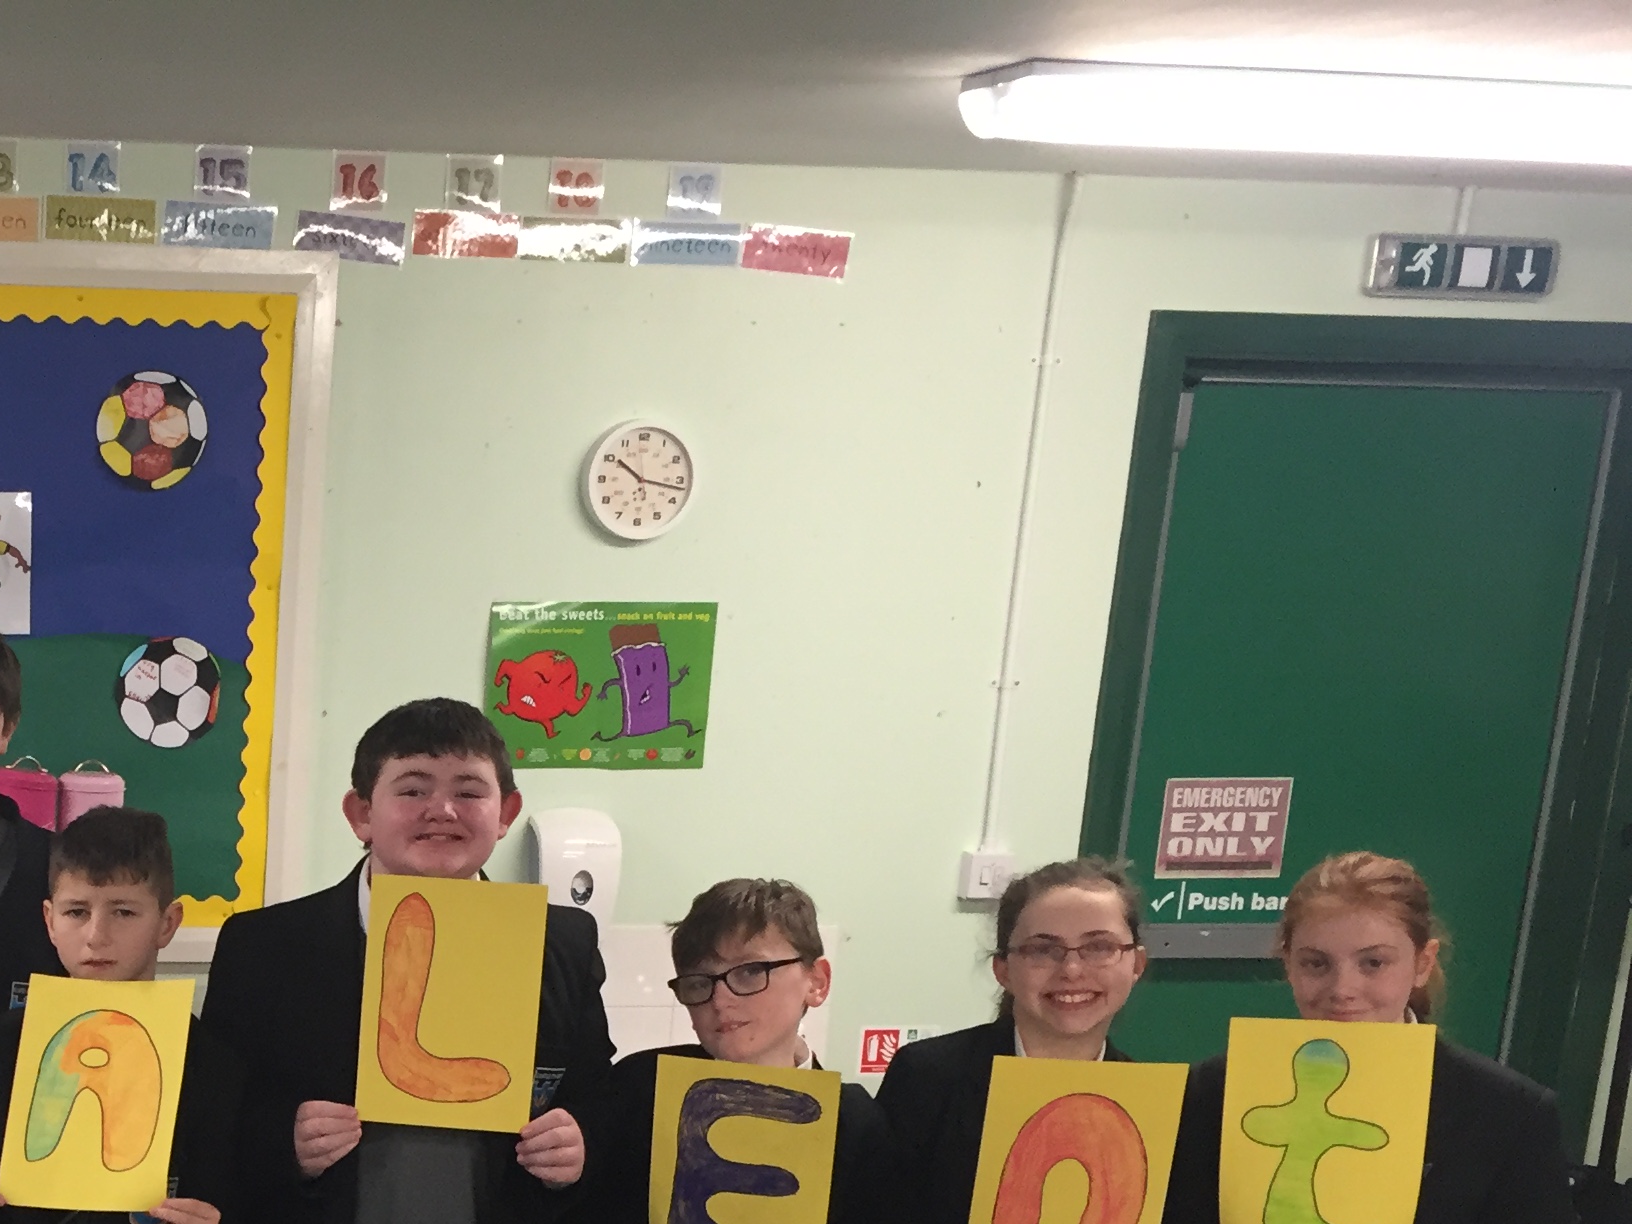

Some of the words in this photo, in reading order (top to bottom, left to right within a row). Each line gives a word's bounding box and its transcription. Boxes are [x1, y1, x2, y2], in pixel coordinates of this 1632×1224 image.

[68, 152, 118, 193] 14
[199, 157, 249, 195] 15
[339, 163, 379, 201] 16
[454, 167, 494, 206] 17
[639, 433, 650, 441] 12
[604, 454, 615, 462] 10
[672, 456, 680, 464] 2
[598, 475, 606, 483] 9
[675, 476, 684, 484] 3
[602, 496, 610, 504] 8
[633, 518, 641, 526] 6
[653, 512, 661, 520] 5
[534, 607, 557, 620] the
[656, 611, 676, 620] fruit
[678, 611, 693, 620] and
[695, 613, 710, 622] veg
[1171, 786, 1283, 808] EMERGENCY
[1169, 811, 1279, 833] EXIT
[1166, 836, 1276, 857] ONLY
[1187, 892, 1244, 911] Push
[1250, 892, 1289, 911] bar
[377, 891, 512, 1104] L
[24, 1008, 163, 1172] A
